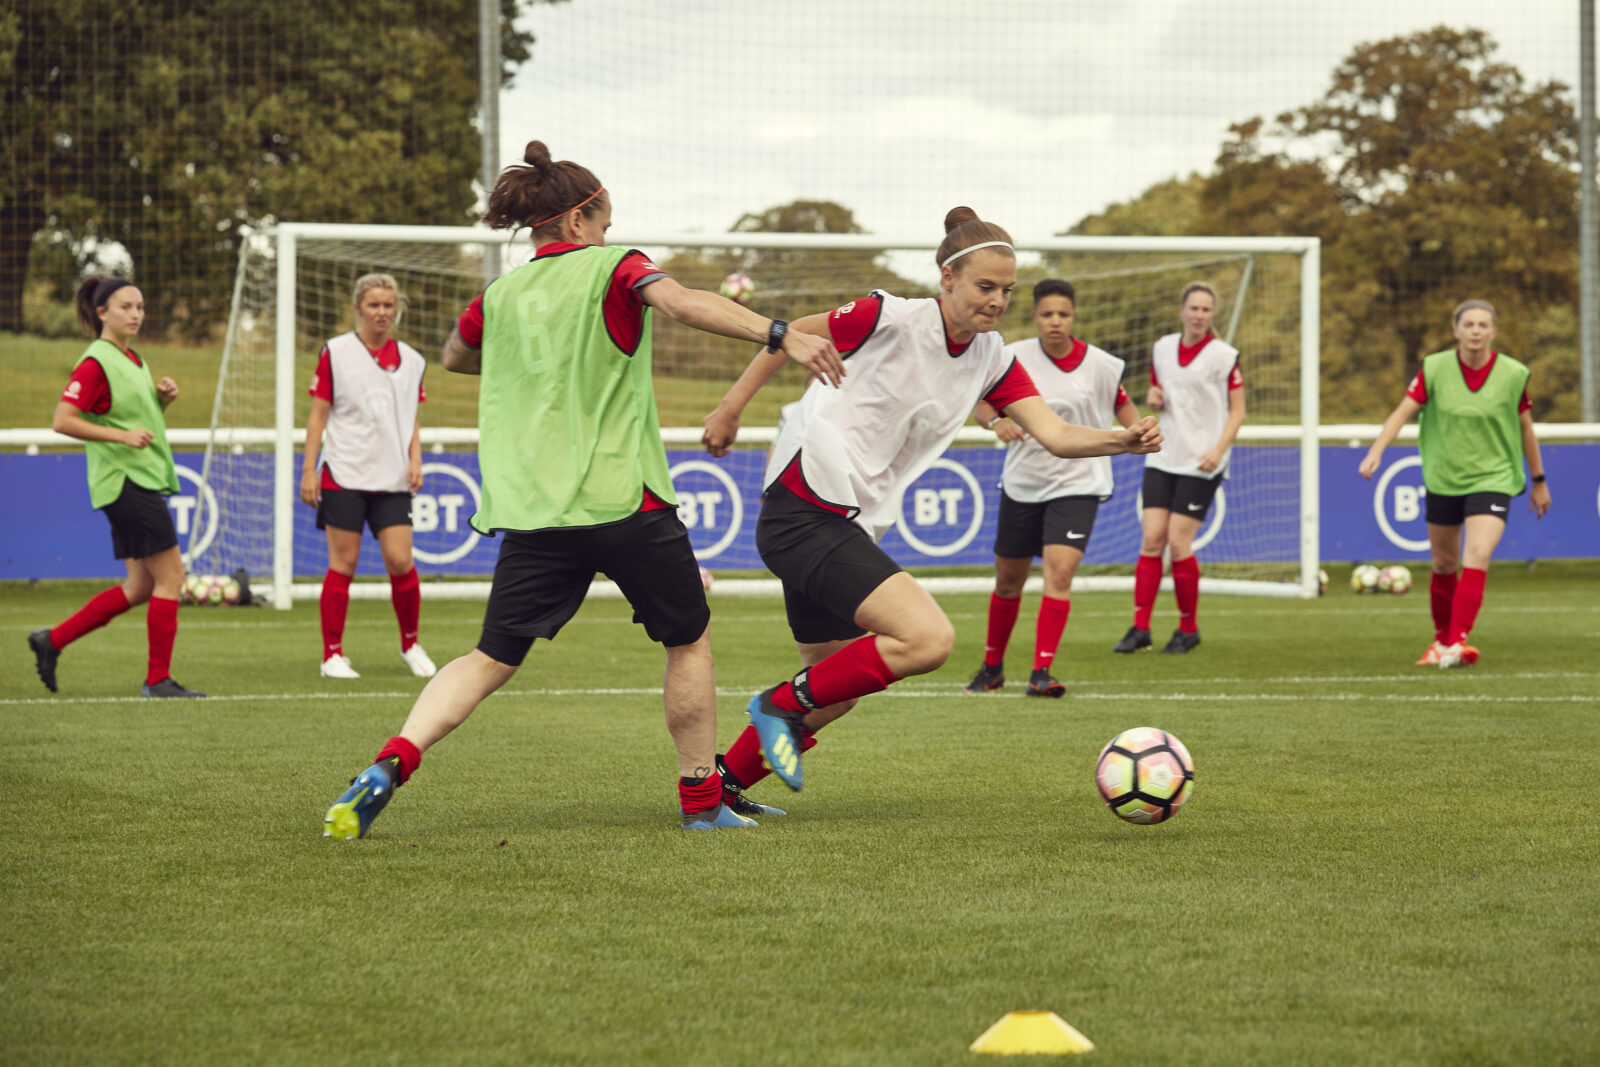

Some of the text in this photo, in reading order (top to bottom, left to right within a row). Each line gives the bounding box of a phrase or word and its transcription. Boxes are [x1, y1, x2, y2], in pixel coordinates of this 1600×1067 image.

[517, 288, 552, 374] 6
[169, 495, 196, 534] T
[411, 494, 464, 532] BT
[675, 491, 722, 529] BT
[914, 488, 964, 526] BT
